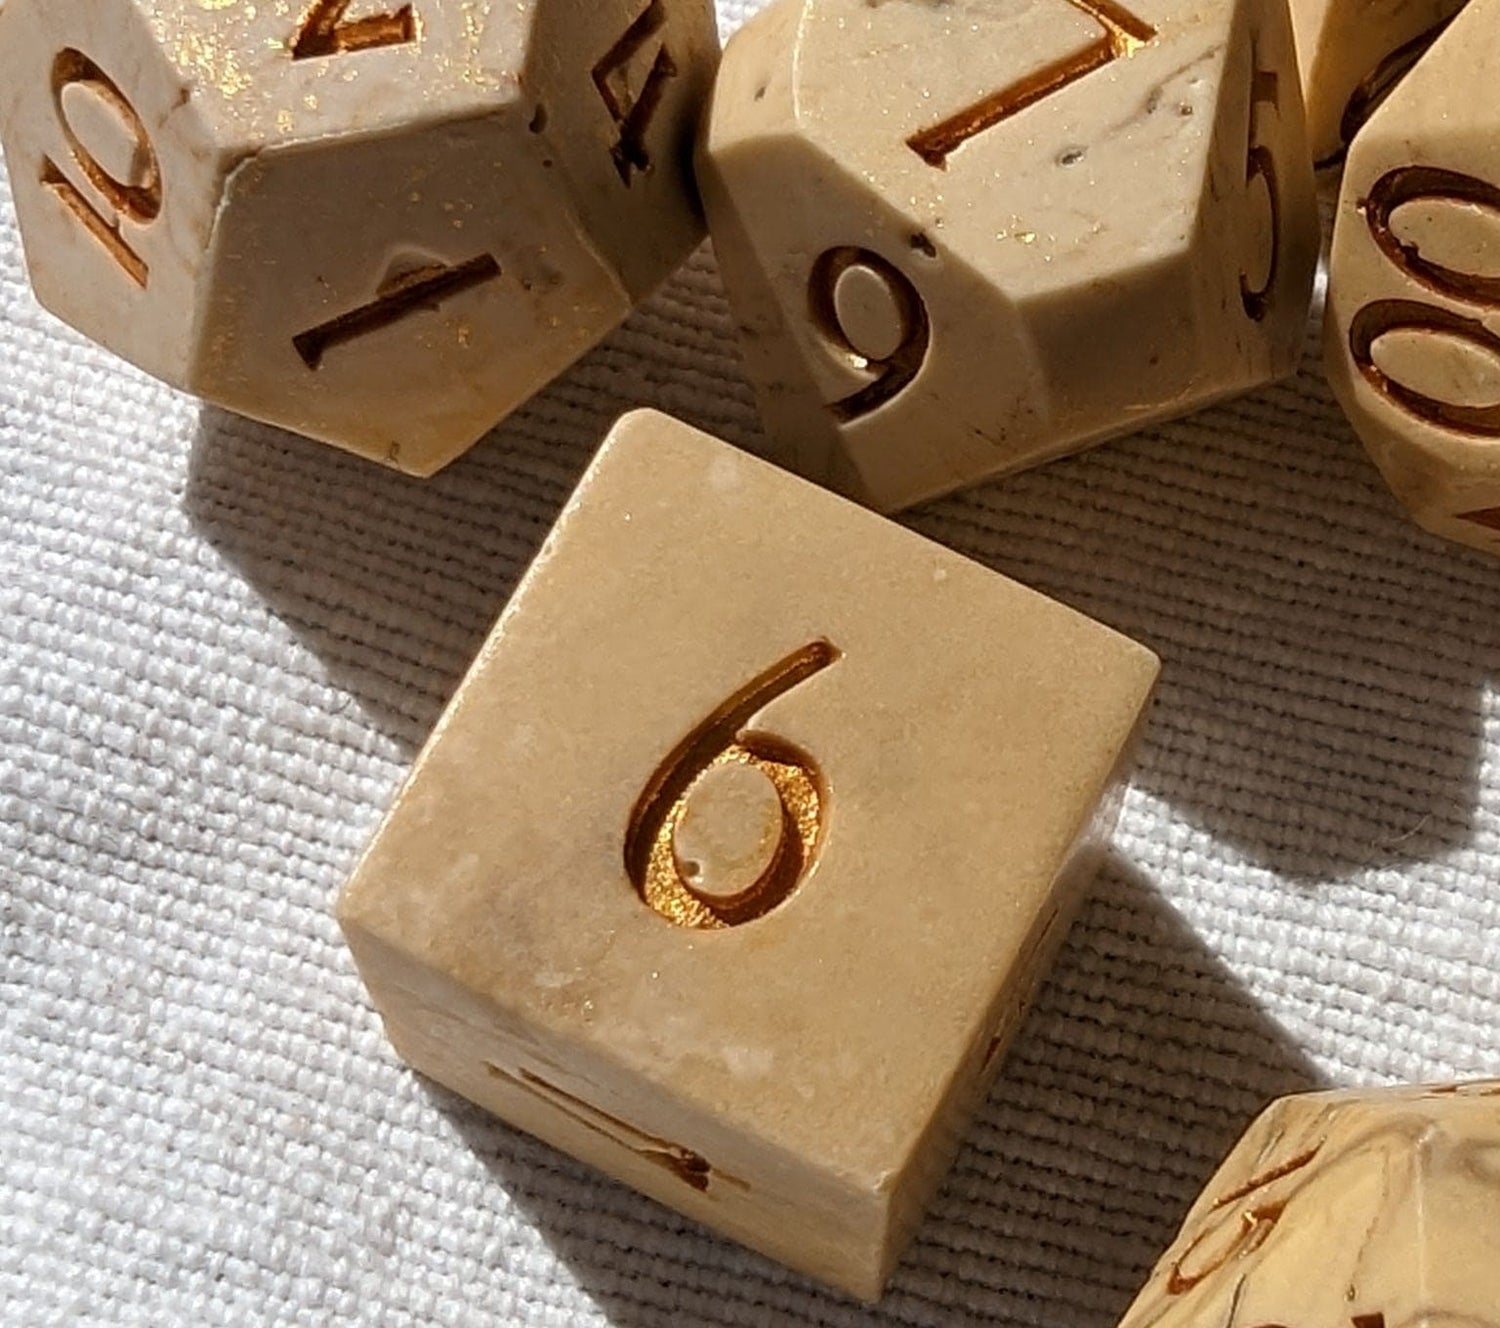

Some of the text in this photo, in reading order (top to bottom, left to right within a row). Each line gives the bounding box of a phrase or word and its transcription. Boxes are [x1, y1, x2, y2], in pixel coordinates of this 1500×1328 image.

[39, 45, 163, 290] 10
[292, 252, 502, 372] 1
[623, 635, 846, 933] 6
